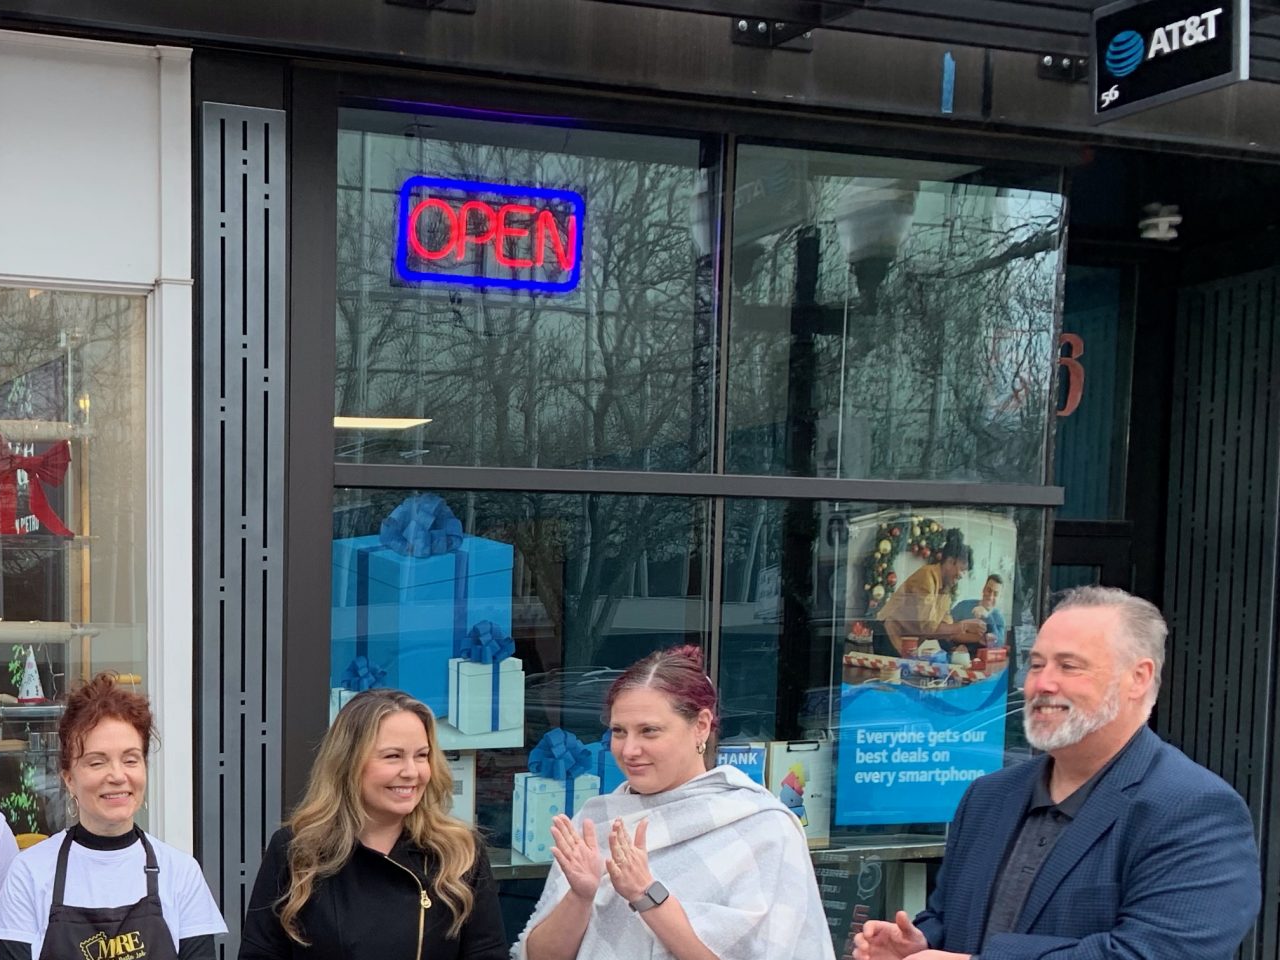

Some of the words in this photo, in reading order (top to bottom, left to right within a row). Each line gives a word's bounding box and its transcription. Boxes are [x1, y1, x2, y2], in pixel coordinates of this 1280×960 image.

[1146, 8, 1222, 60] AT&T
[1101, 84, 1119, 108] 56
[408, 198, 577, 271] OPEN
[857, 729, 925, 747] Everyone
[928, 731, 960, 747] gets
[962, 731, 987, 743] our
[718, 752, 758, 765] HANK
[856, 748, 888, 764] best
[891, 747, 929, 763] deals
[932, 750, 950, 762] on
[855, 771, 895, 787] every
